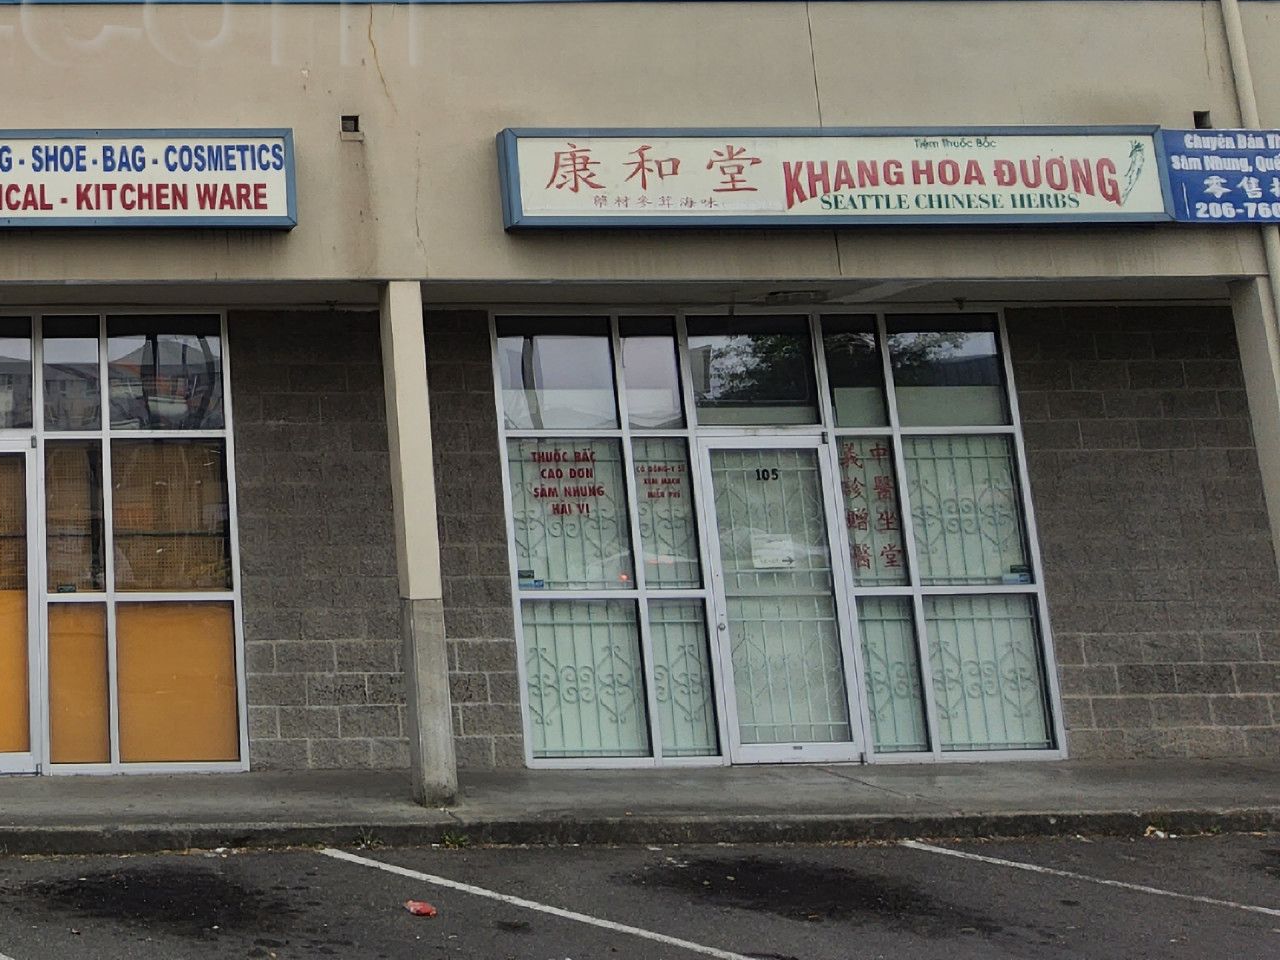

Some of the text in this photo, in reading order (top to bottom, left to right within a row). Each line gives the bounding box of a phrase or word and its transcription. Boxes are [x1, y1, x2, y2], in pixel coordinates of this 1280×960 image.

[31, 145, 87, 172] SHOE
[102, 145, 146, 172] BAG
[164, 144, 285, 172] COSMETICS
[545, 142, 763, 193] 康和堂
[782, 159, 905, 210] KHANG
[911, 159, 986, 185] HOA
[76, 182, 189, 211] KITCHEN
[195, 183, 269, 210] WARE
[821, 192, 1080, 210] SEATTLE CHINESE HERBS
[540, 468, 563, 479] CAO
[755, 468, 779, 481] 105
[564, 486, 605, 497] NHUNG
